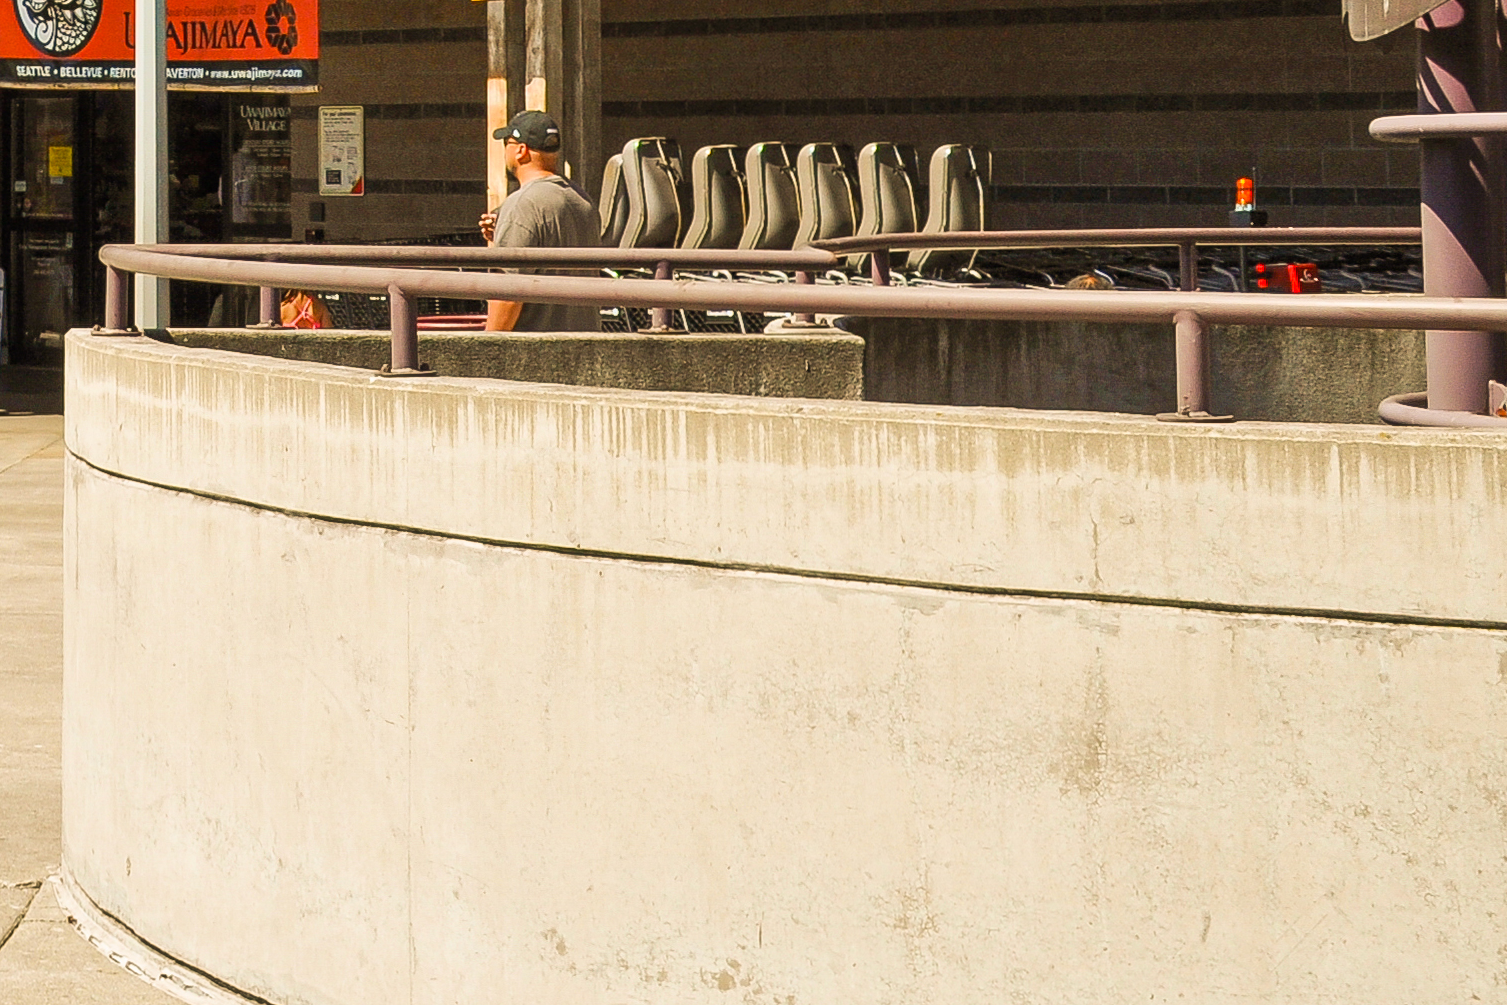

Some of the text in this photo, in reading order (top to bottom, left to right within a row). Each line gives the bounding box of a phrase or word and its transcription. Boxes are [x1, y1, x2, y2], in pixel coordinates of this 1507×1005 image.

[123, 11, 263, 55] UAJIMAYA
[16, 65, 51, 77] SEATTLE
[60, 66, 102, 78] BELLEVUE
[166, 67, 204, 79] AVERTON
[210, 67, 302, 81] www.uwajimaya.com
